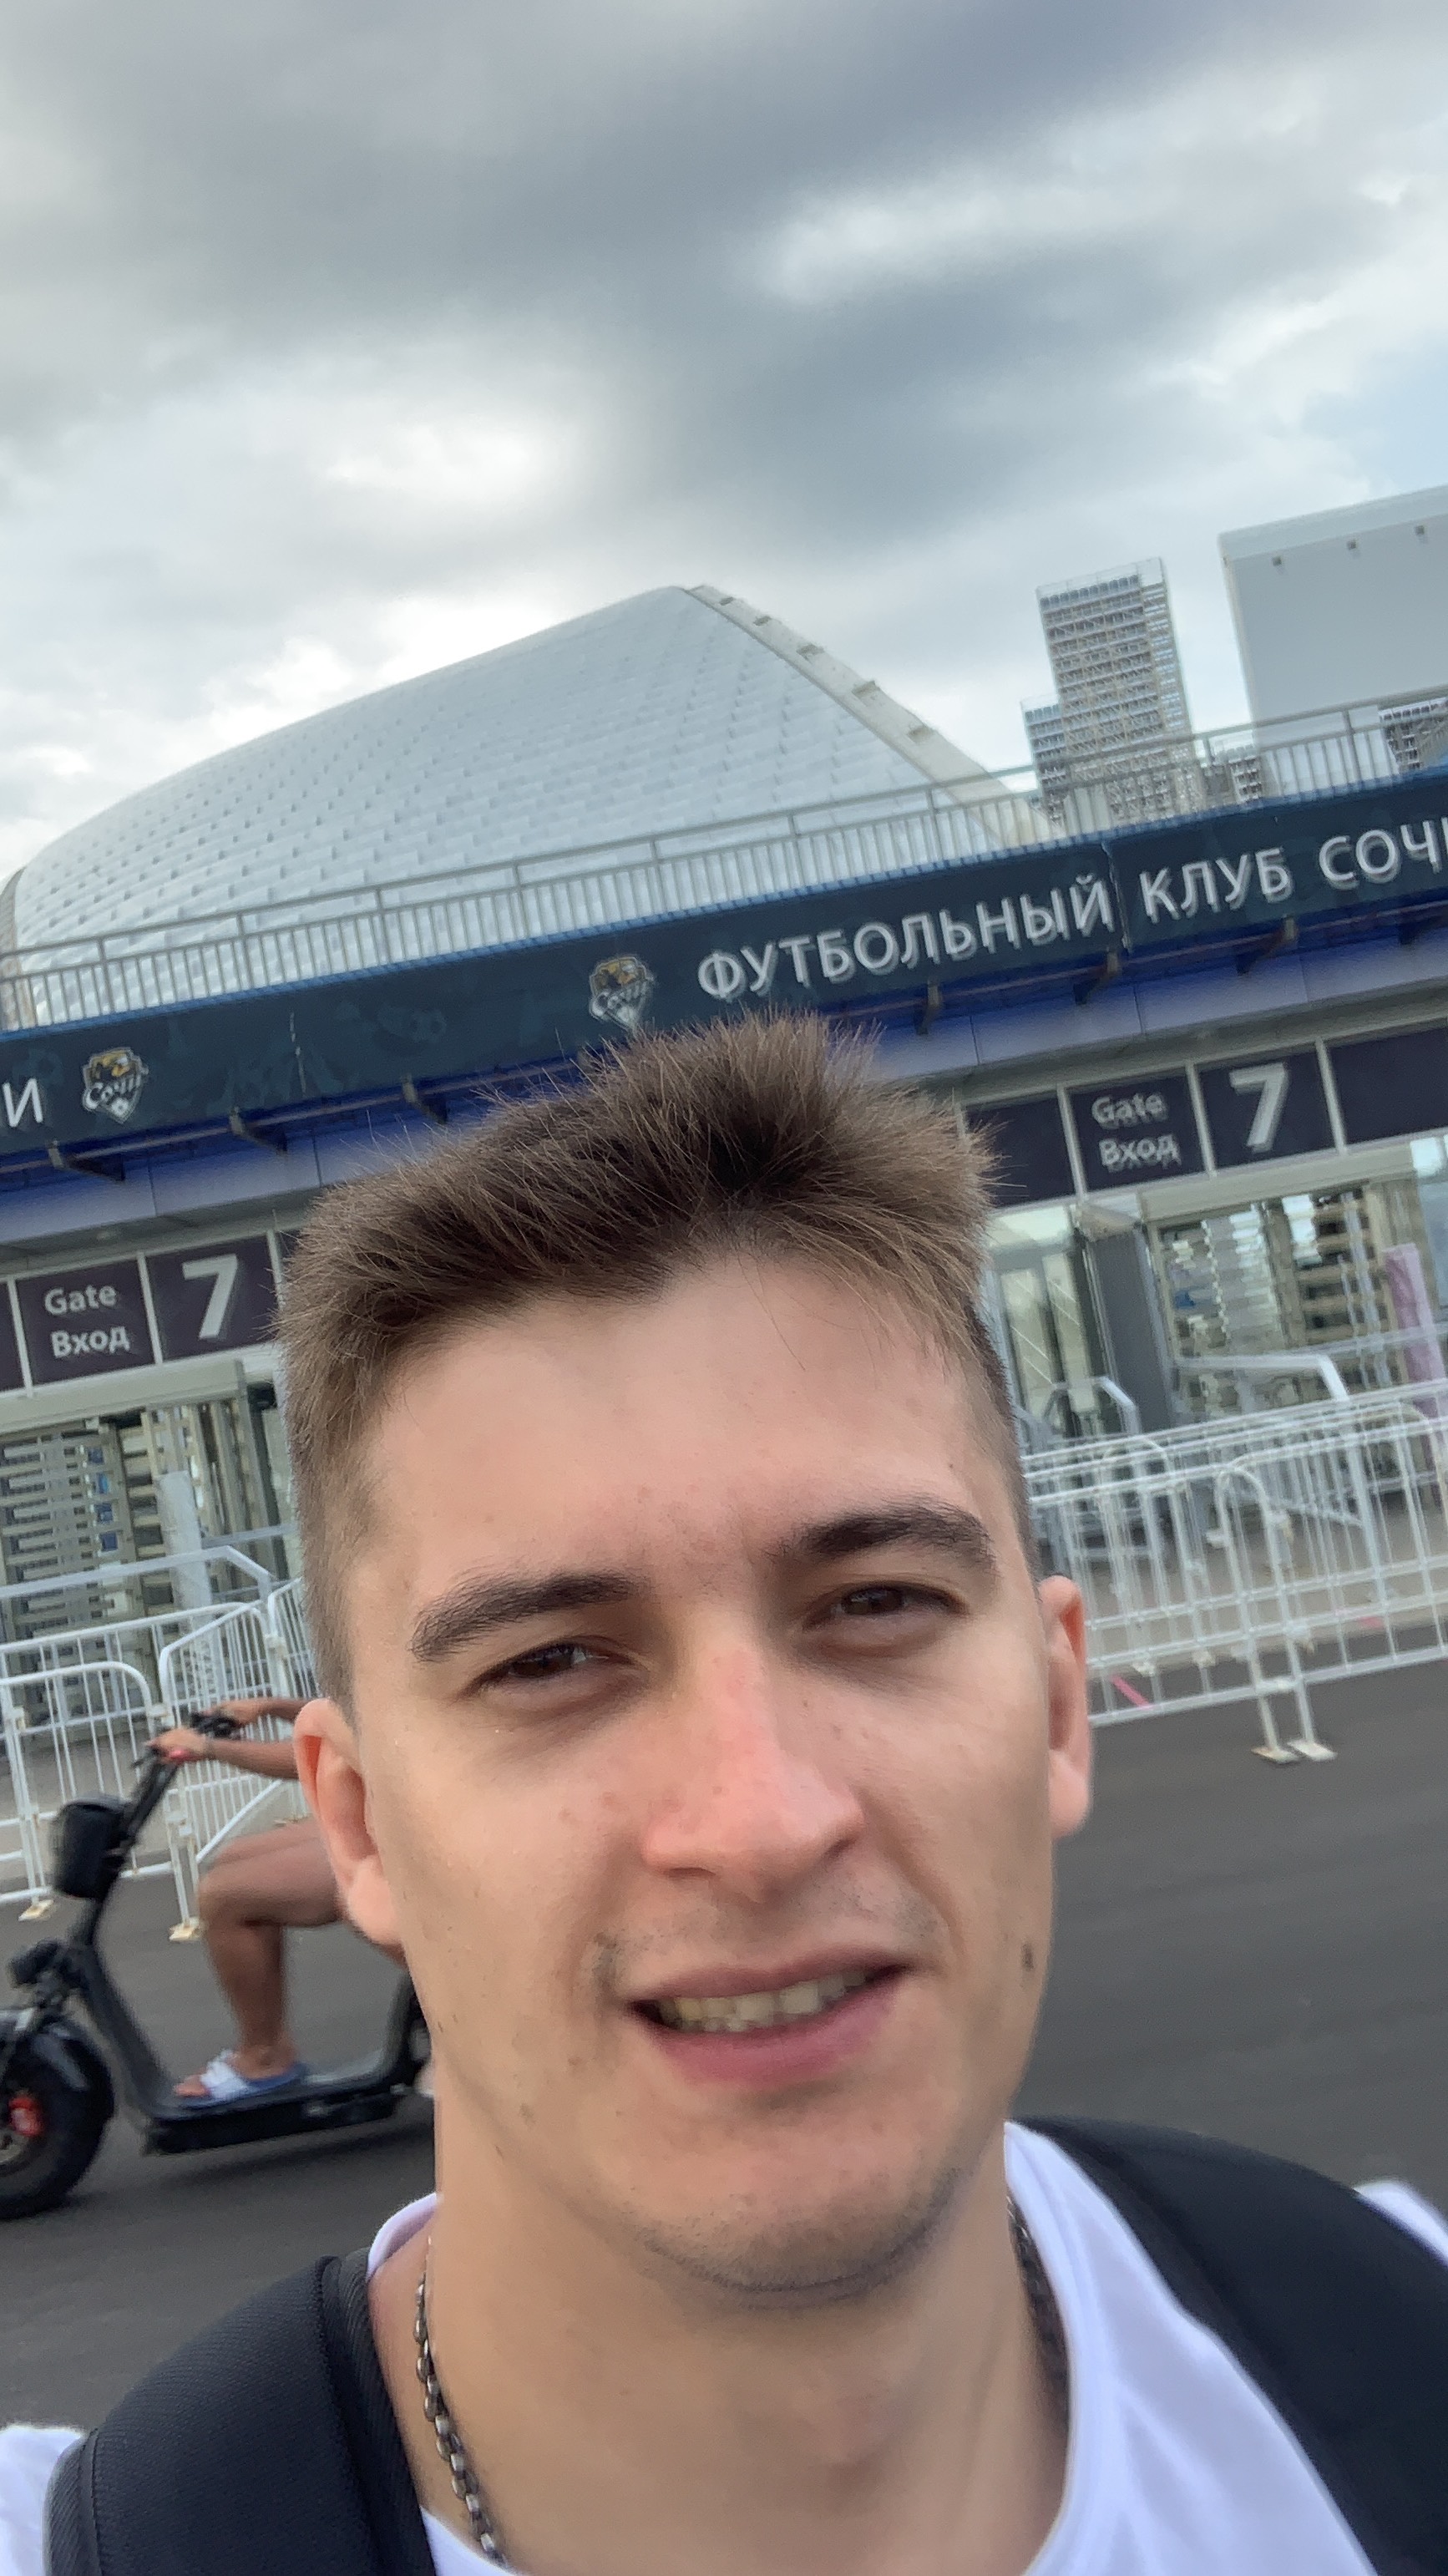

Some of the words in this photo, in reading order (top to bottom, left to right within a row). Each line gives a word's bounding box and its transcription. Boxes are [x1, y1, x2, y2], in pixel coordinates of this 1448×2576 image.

[696, 874, 1115, 1001] ФУТБОЛЬНЫЙ
[1140, 846, 1292, 923] КЛУБ
[1319, 817, 1448, 890] СОЧ
[1091, 1092, 1167, 1129] Gate
[1228, 1062, 1289, 1152] 7
[1099, 1133, 1182, 1172] Вход
[44, 1285, 117, 1316] Gate
[181, 1253, 240, 1340] 7
[50, 1326, 130, 1359] Вход
